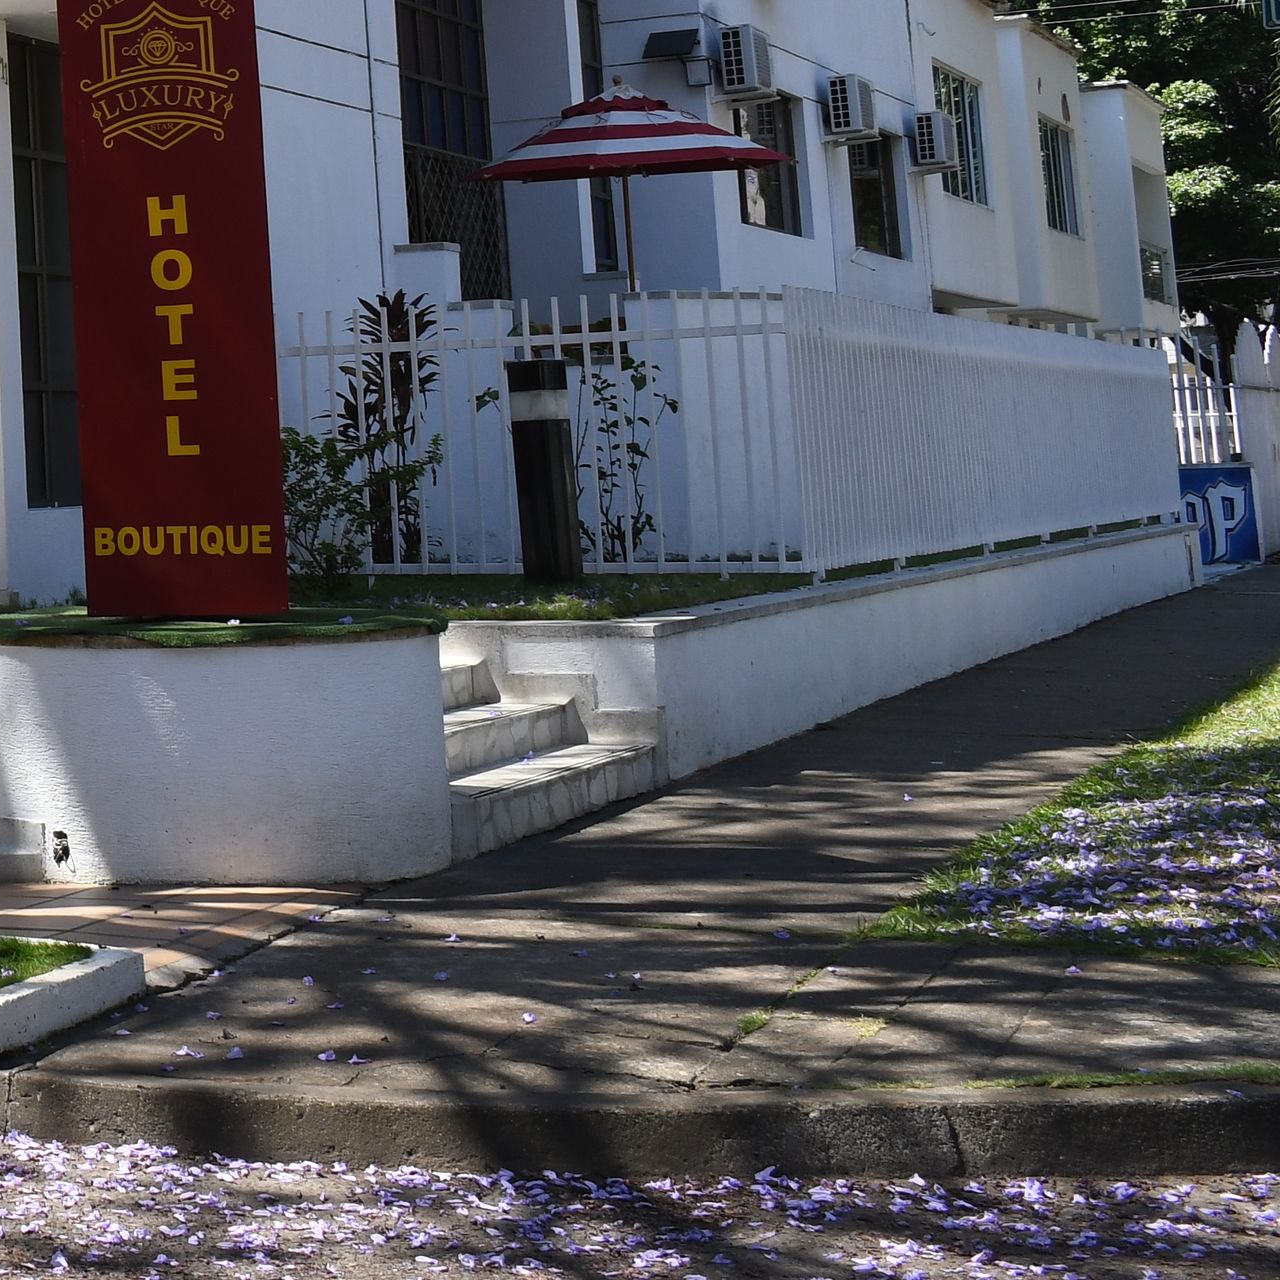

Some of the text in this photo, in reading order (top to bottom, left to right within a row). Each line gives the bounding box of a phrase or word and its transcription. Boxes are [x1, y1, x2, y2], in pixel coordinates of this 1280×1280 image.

[100, 84, 226, 120] LUXURY
[150, 123, 174, 131] STAR
[146, 194, 200, 456] HOTEL
[94, 525, 272, 557] BOUTIQUE
